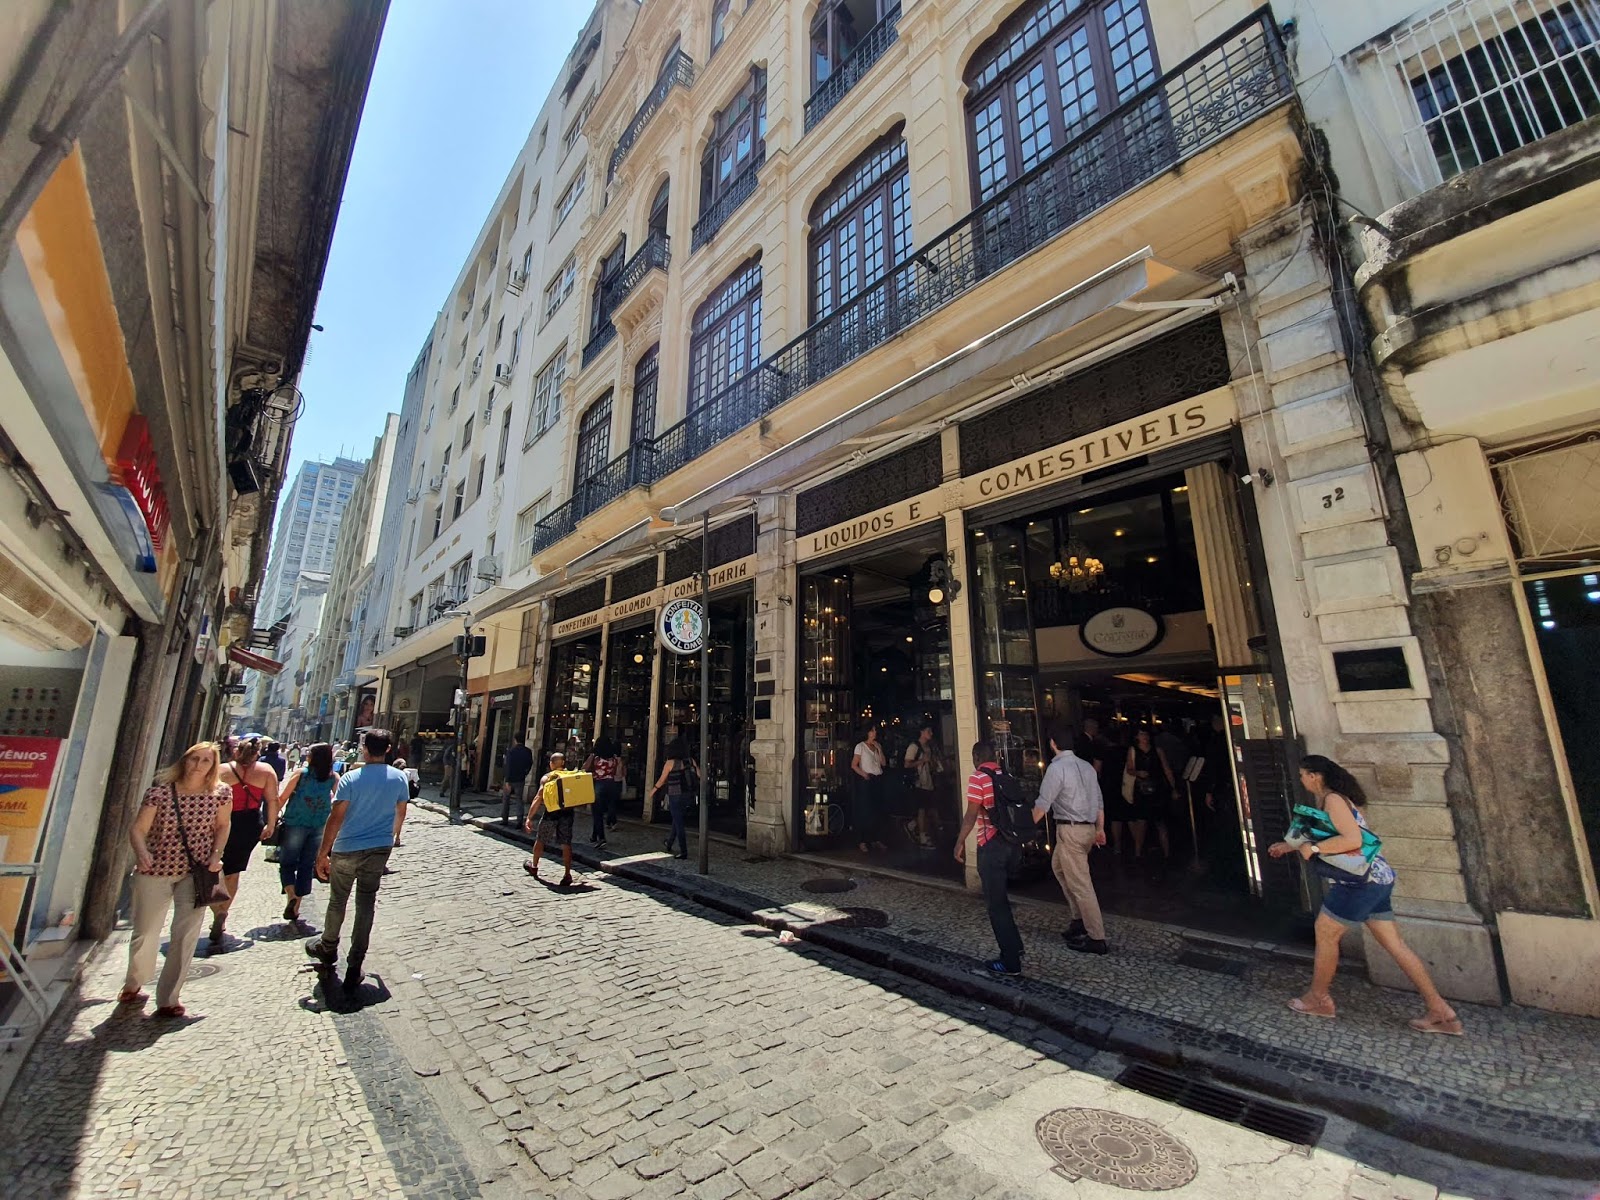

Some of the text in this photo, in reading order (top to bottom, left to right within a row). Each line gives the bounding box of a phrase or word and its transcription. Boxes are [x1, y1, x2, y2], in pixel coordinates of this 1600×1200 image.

[979, 404, 1207, 496] COMESTIVEIS
[1321, 486, 1345, 509] 32
[813, 501, 921, 552] LIQUIDOS E
[674, 562, 747, 598] CONFITARIA
[614, 596, 652, 617] COLOMBO
[558, 614, 598, 634] CONFEITARIA
